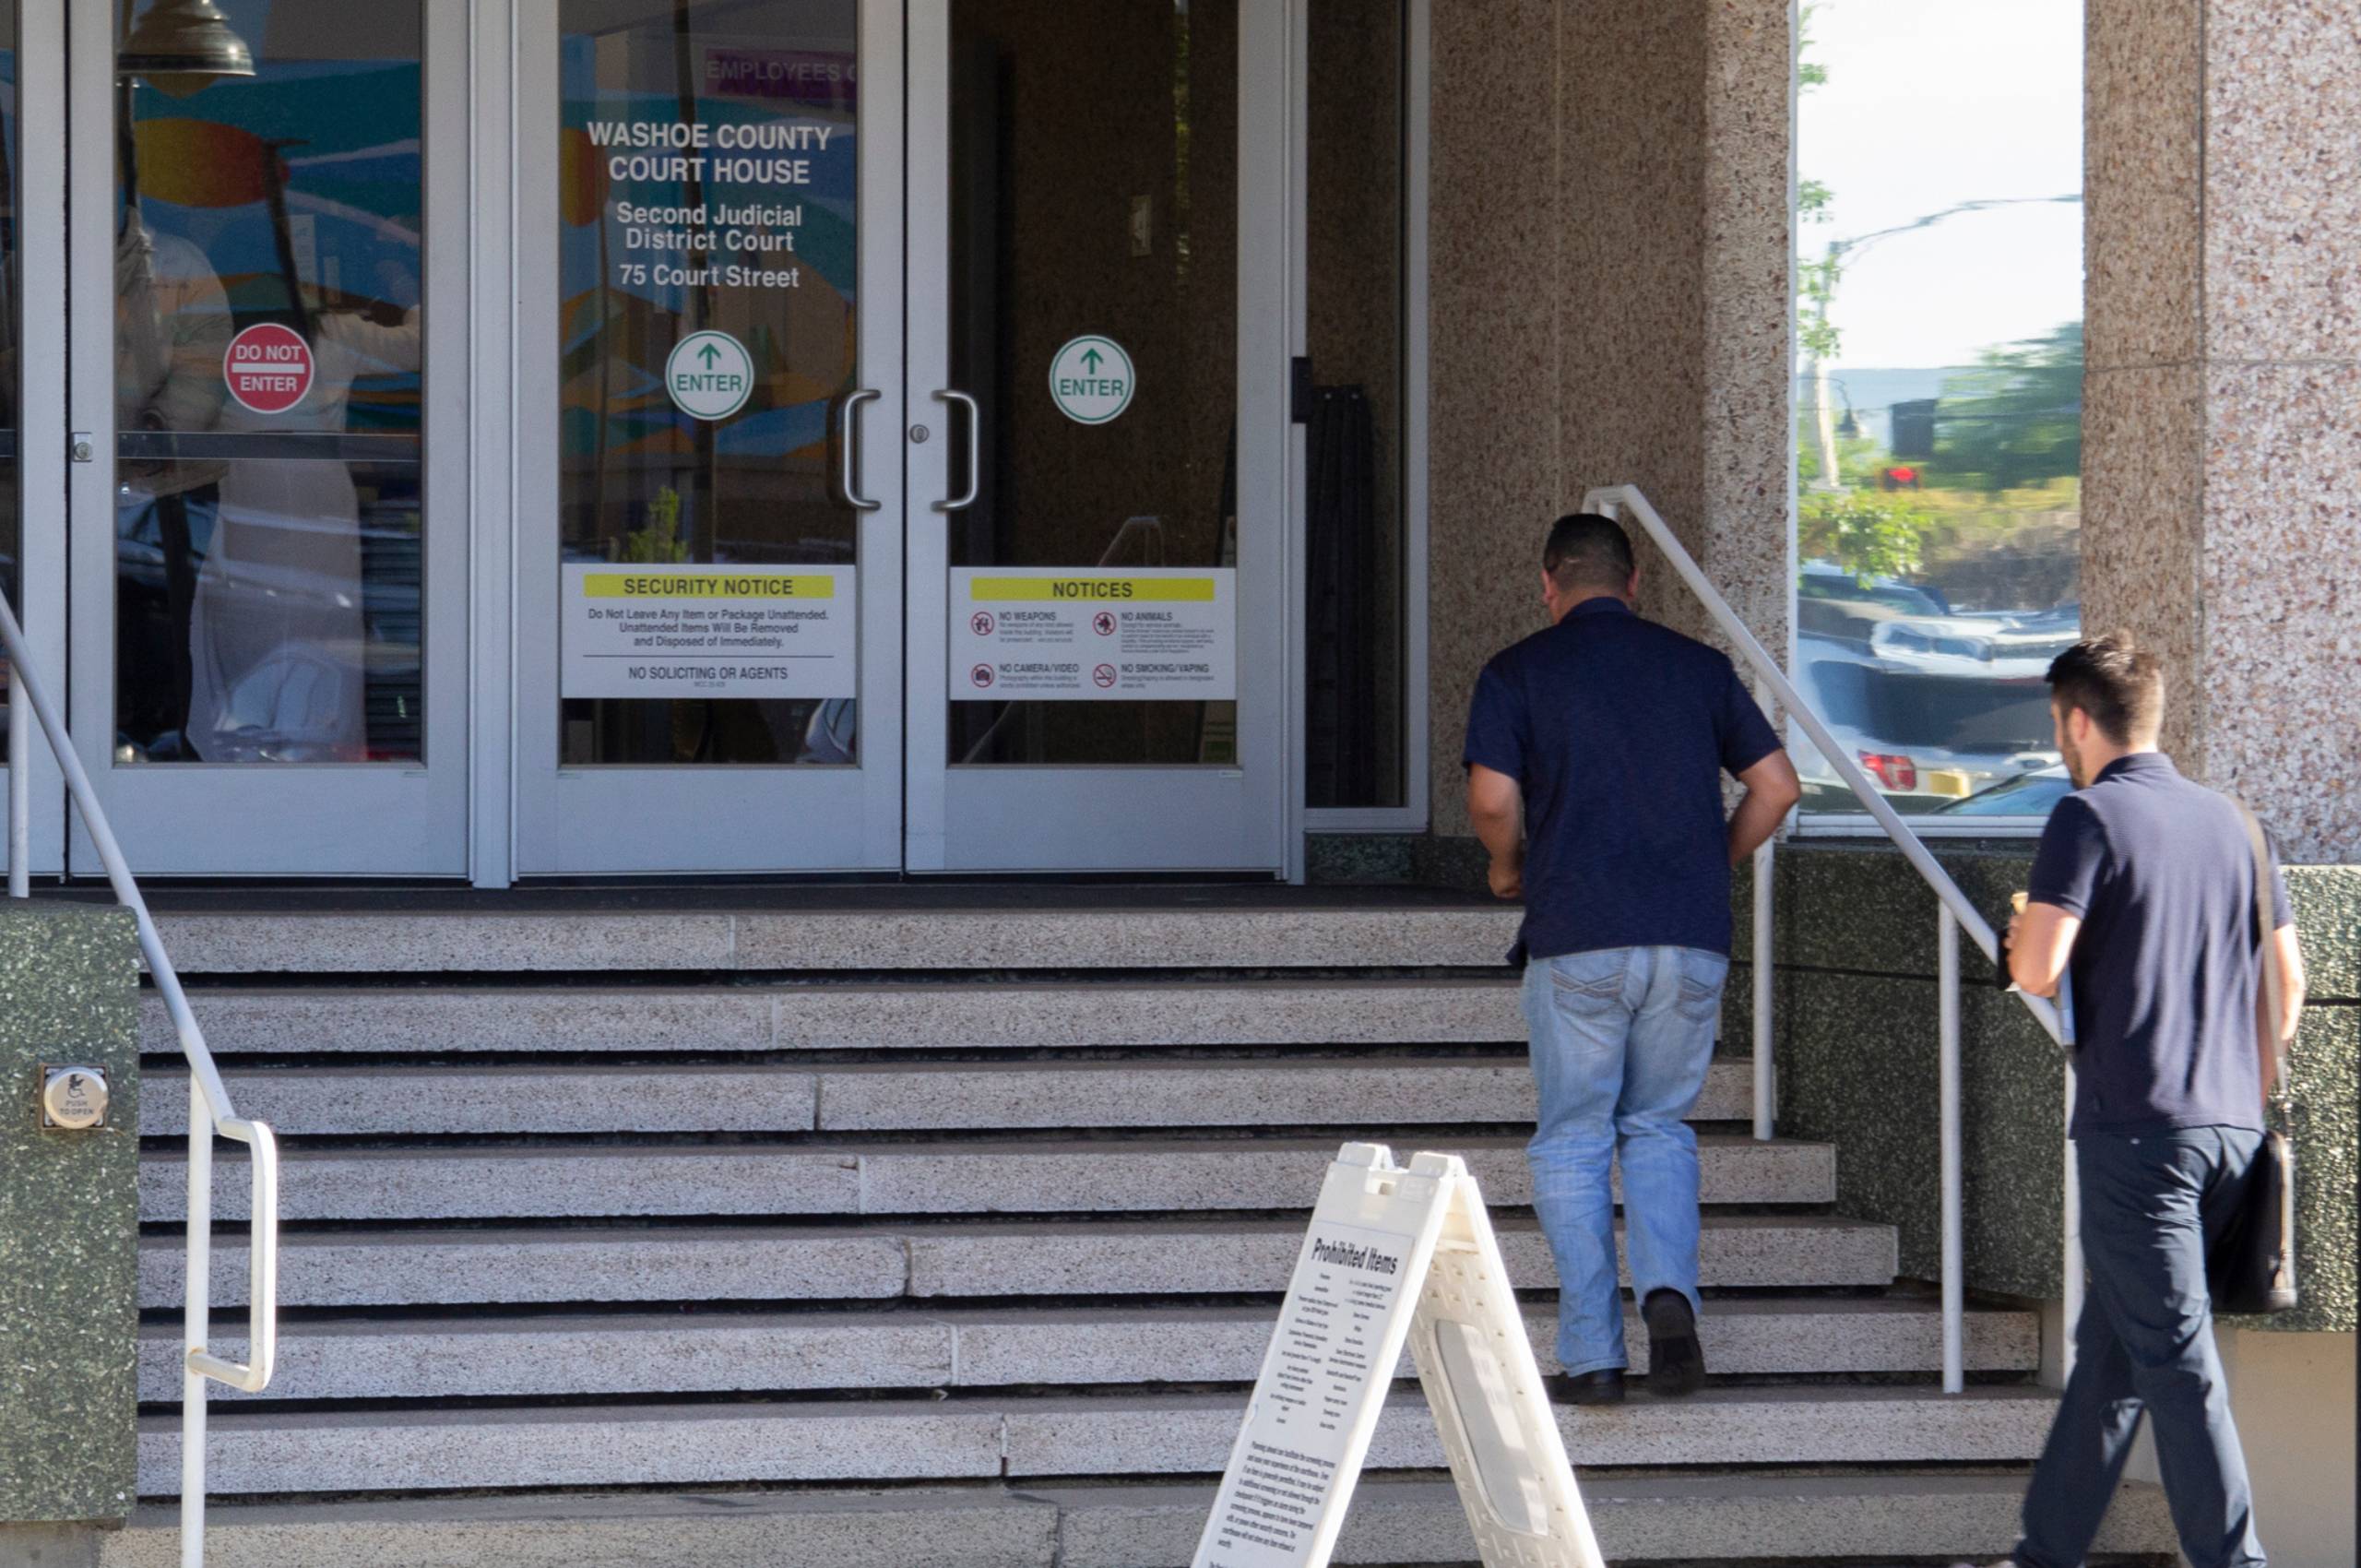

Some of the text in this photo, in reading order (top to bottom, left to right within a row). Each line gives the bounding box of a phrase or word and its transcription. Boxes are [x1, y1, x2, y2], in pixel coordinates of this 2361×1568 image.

[706, 60, 841, 82] EMPLOYEES
[587, 122, 832, 150] WASHOE COUNTY
[609, 156, 811, 184] COURT HOUSE
[616, 201, 802, 227] Second Judicial
[626, 228, 794, 252] District Court
[620, 264, 800, 288] 75 Court Street
[235, 345, 302, 361] DO NOT
[240, 375, 298, 392] ENTER
[677, 374, 742, 392] ENTER
[1060, 378, 1124, 397] ENTER
[623, 578, 793, 595] SECURITY NOTICE
[1052, 582, 1133, 599] NOTICES
[588, 609, 829, 623] Do Not Leave Any Item or Package Unattended.
[999, 612, 1057, 622] NO WEAPONS
[1121, 612, 1134, 622] NO
[619, 623, 799, 634] Unattended Items Will Be Removed
[634, 636, 784, 649] and Disposed of Immediately.
[628, 666, 789, 680] NO SOLICITING OR AGENTS
[999, 663, 1012, 673] NO
[1121, 663, 1134, 673] NO
[1311, 1237, 1398, 1275] Prohibited Items
